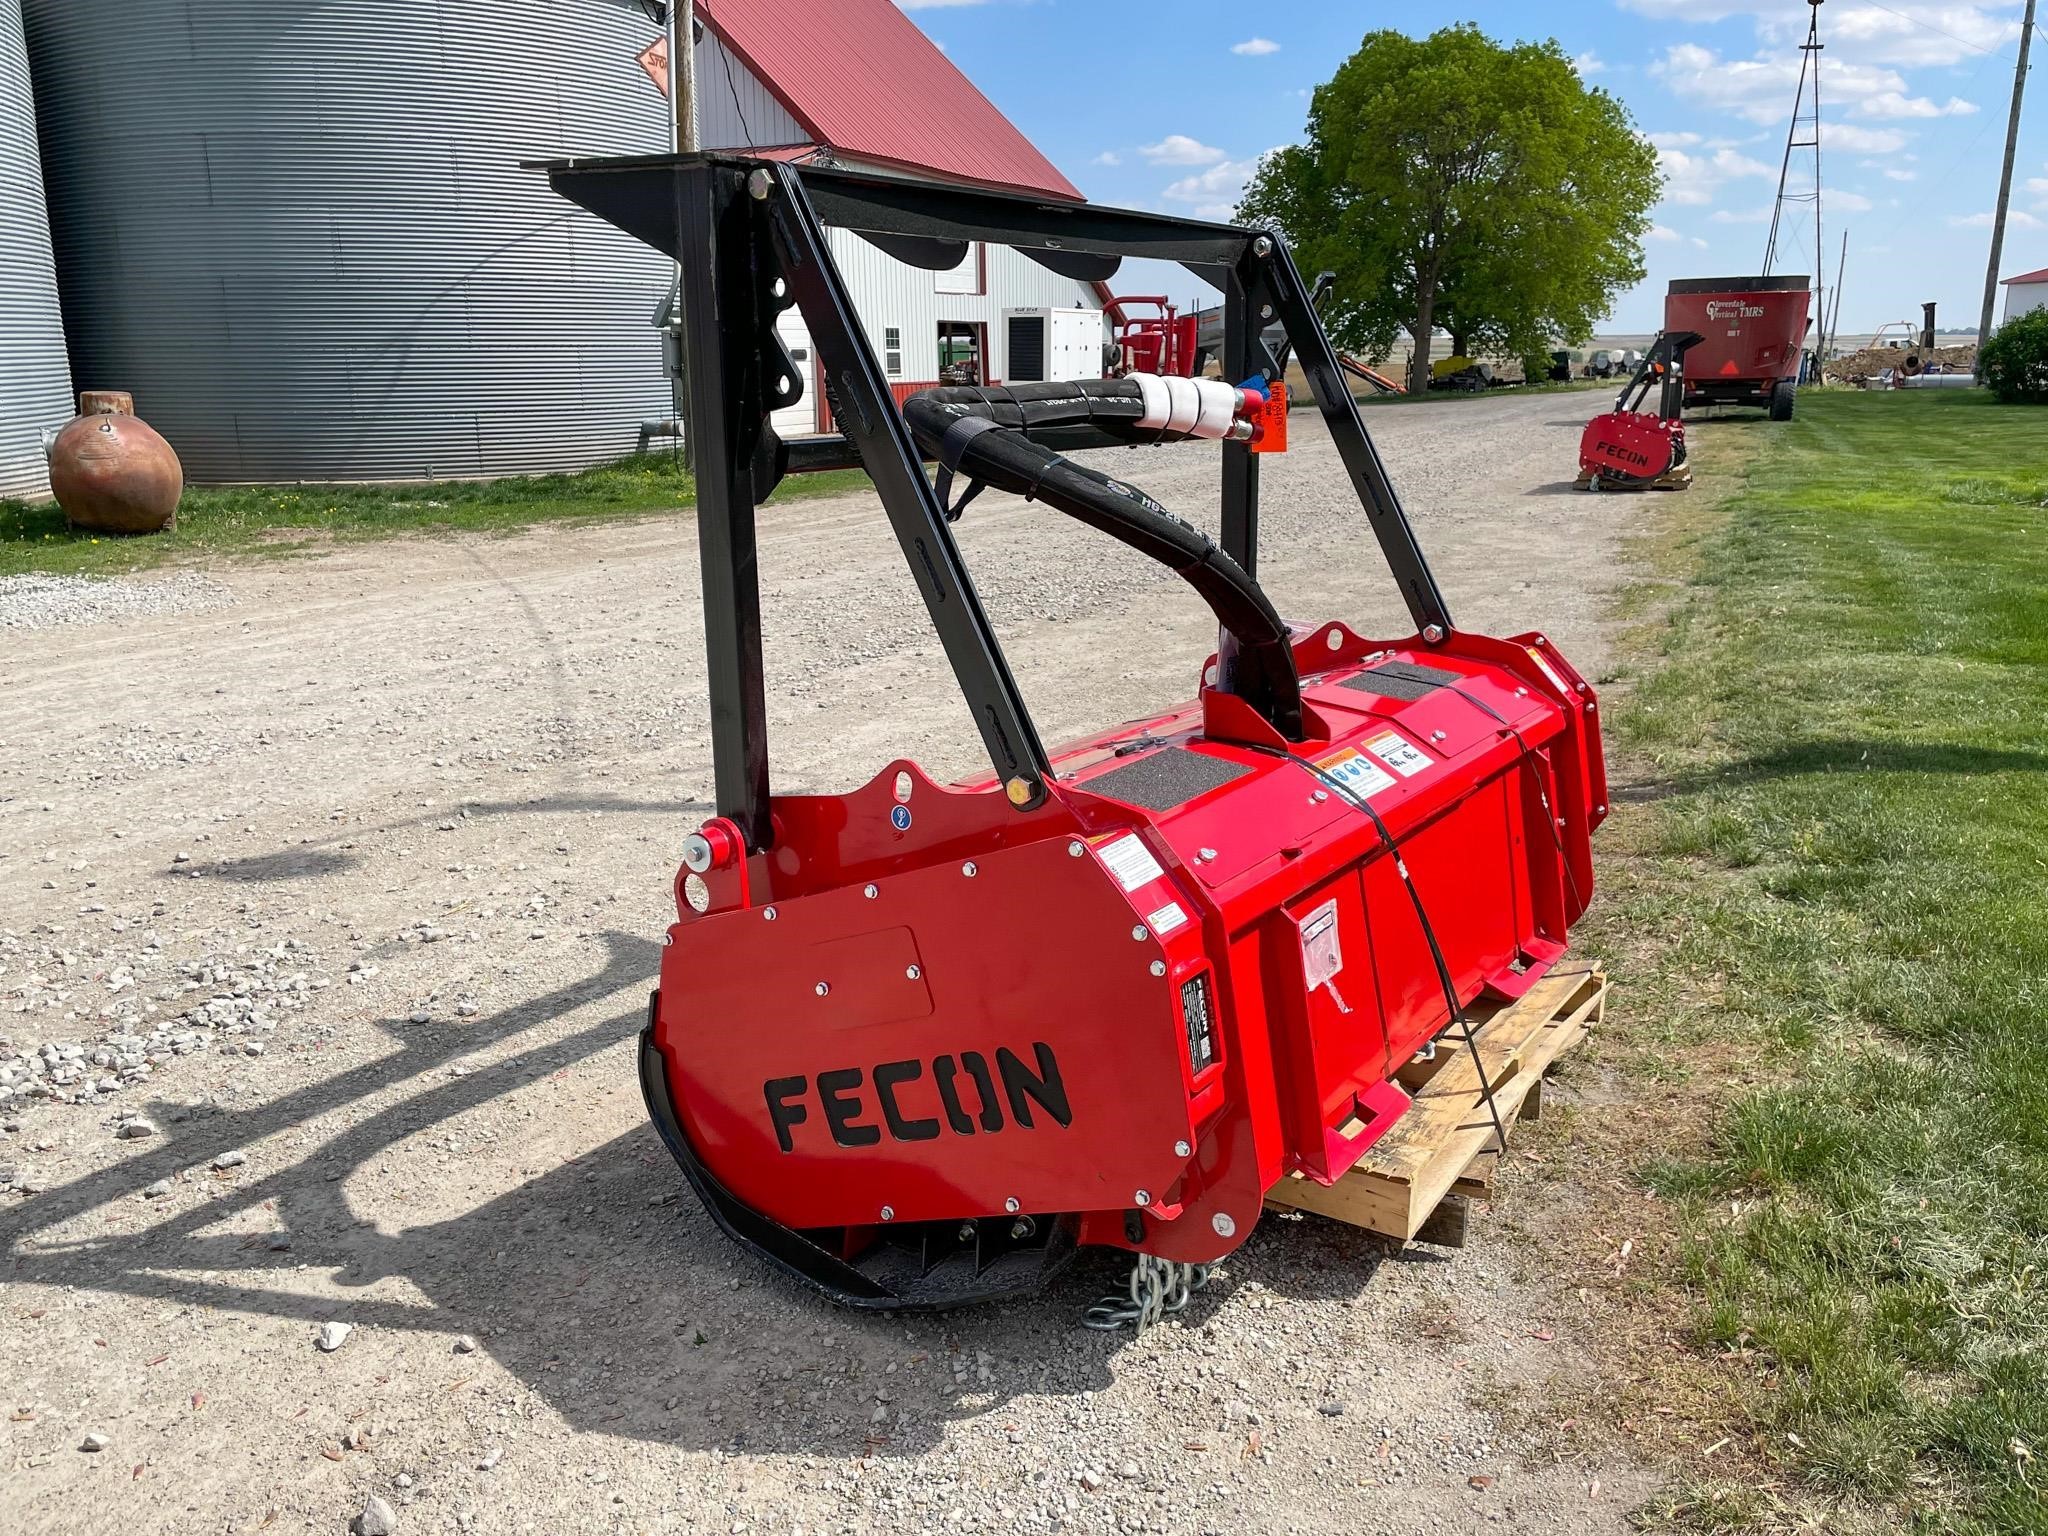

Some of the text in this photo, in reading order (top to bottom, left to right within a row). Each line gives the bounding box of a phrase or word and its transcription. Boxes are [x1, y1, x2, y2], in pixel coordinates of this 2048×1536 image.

[1706, 300, 1746, 315] Cloverdale
[1709, 306, 1765, 321] Vertical TMRS
[1596, 441, 1649, 467] FECON
[763, 1041, 1073, 1155] FECON
